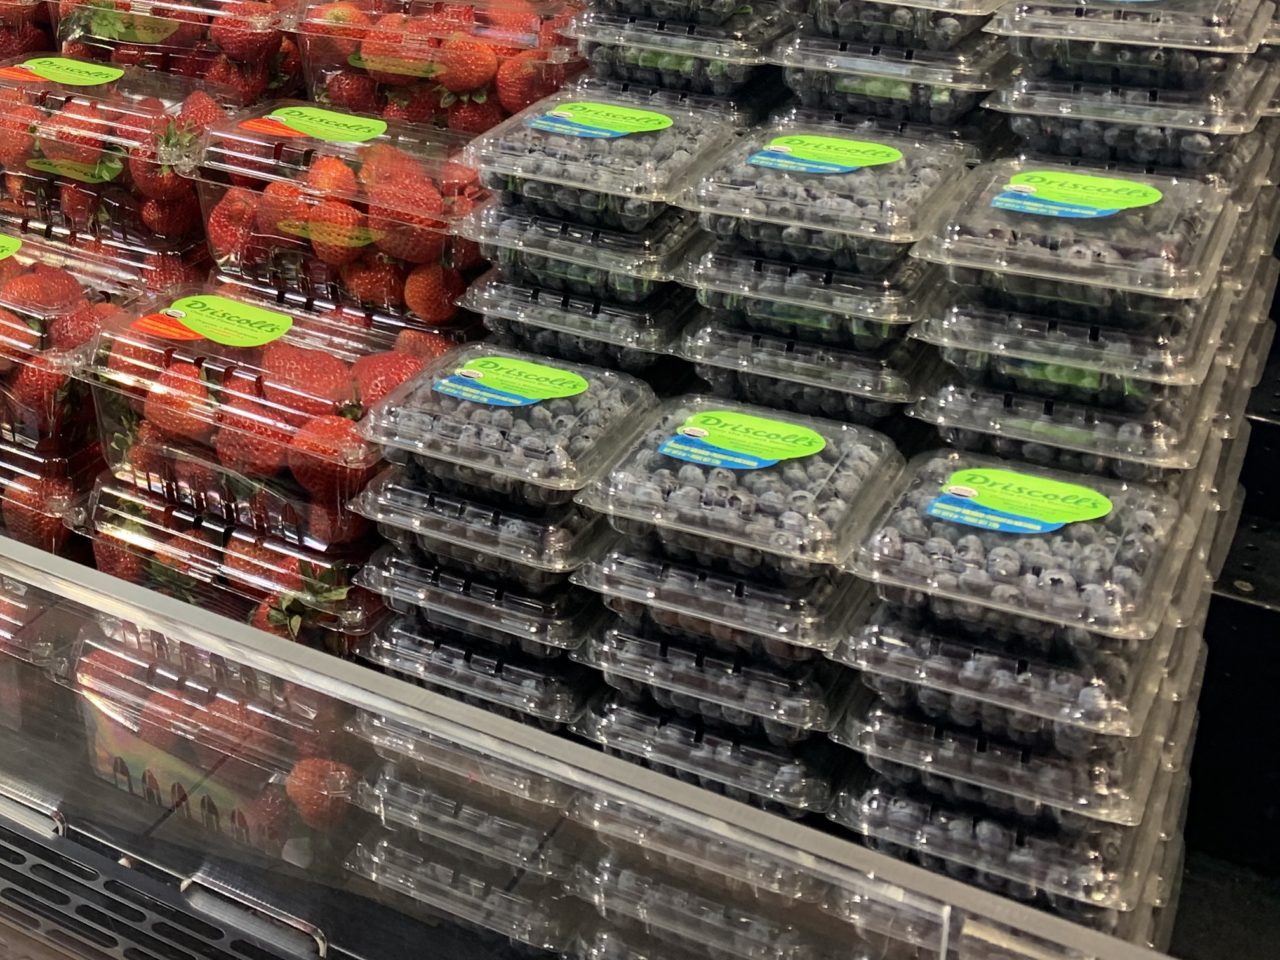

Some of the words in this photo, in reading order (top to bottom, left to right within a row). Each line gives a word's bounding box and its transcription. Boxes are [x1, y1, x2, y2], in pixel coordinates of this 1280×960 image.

[285, 109, 376, 134] Driscoll's
[789, 138, 892, 160] Driscoll's
[1025, 176, 1150, 200] Driscoll's
[186, 300, 280, 333] Driscoll's
[478, 360, 582, 390] Driscoll's
[701, 415, 816, 448] Driscoll's
[964, 473, 1099, 509] Driscoll's
